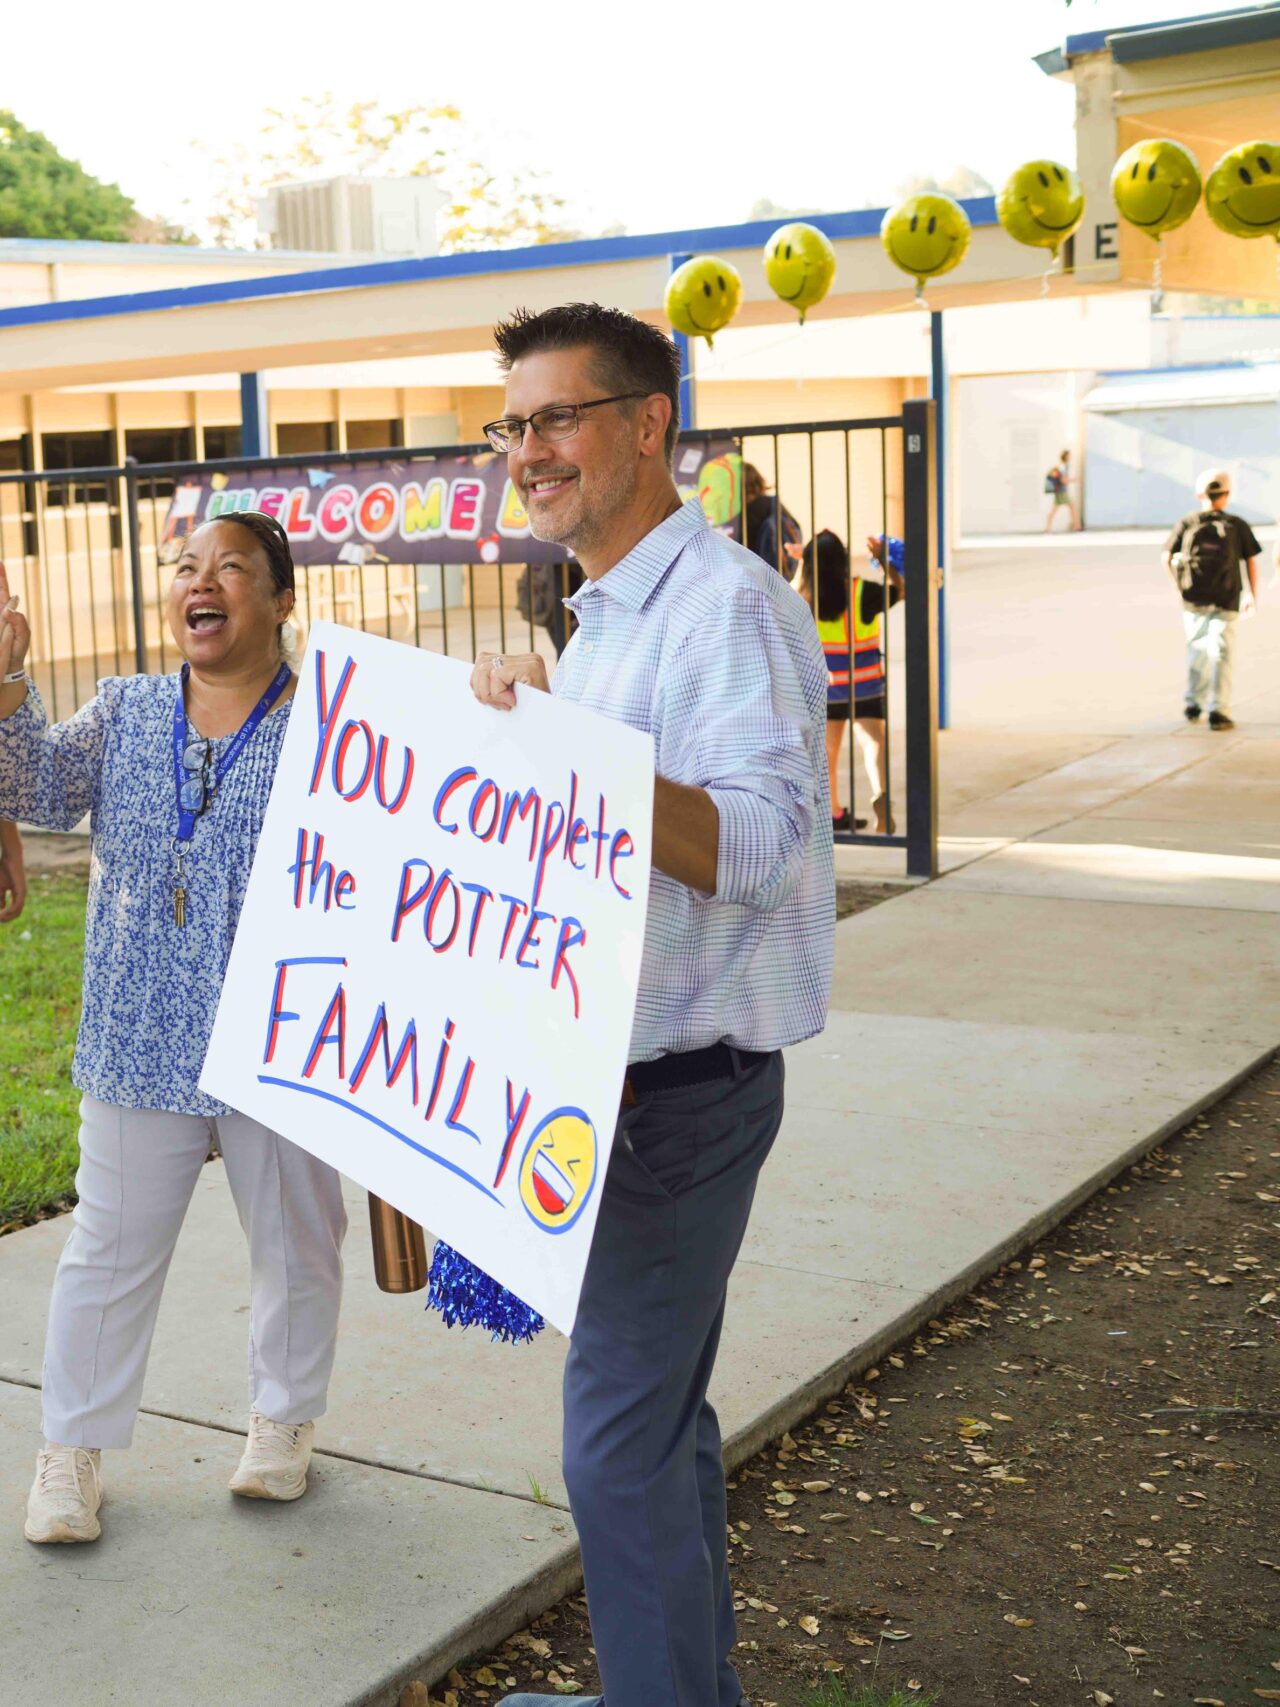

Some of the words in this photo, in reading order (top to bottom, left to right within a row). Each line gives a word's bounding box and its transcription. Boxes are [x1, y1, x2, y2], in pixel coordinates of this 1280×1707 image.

[1095, 223, 1118, 259] E
[287, 827, 357, 913] the
[391, 858, 587, 1019] POTTER
